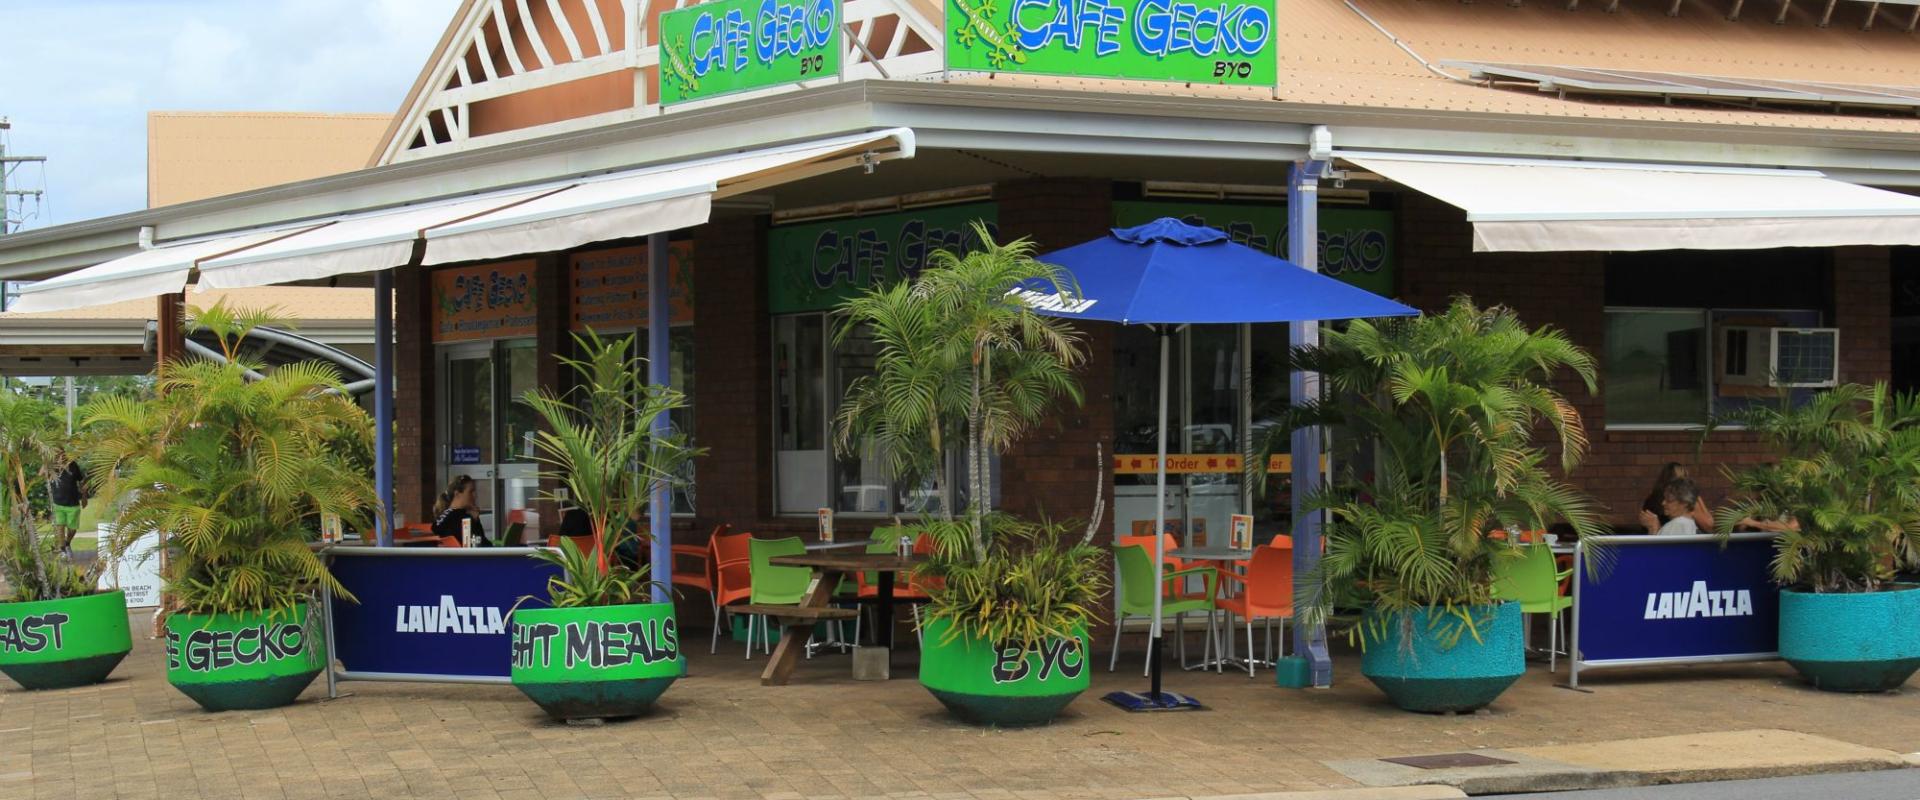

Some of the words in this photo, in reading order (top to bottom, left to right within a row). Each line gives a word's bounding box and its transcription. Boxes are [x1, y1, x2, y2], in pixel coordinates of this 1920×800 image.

[690, 9, 752, 76] CAFE
[756, 0, 836, 64] GECKO
[1013, 0, 1126, 56] CAFE
[1134, 0, 1271, 57] GECKO
[800, 55, 824, 76] BYO
[1213, 61, 1252, 78] BYO
[813, 229, 890, 289] CAFE
[896, 219, 999, 279] GECK
[1276, 223, 1387, 275] ECKO
[1166, 458, 1199, 469] Order
[396, 595, 505, 634] LAVAZZA
[1644, 580, 1753, 619] LAVAZZA
[185, 622, 305, 672] GECKO
[565, 617, 679, 669] MEALS
[992, 636, 1084, 684] BYO
